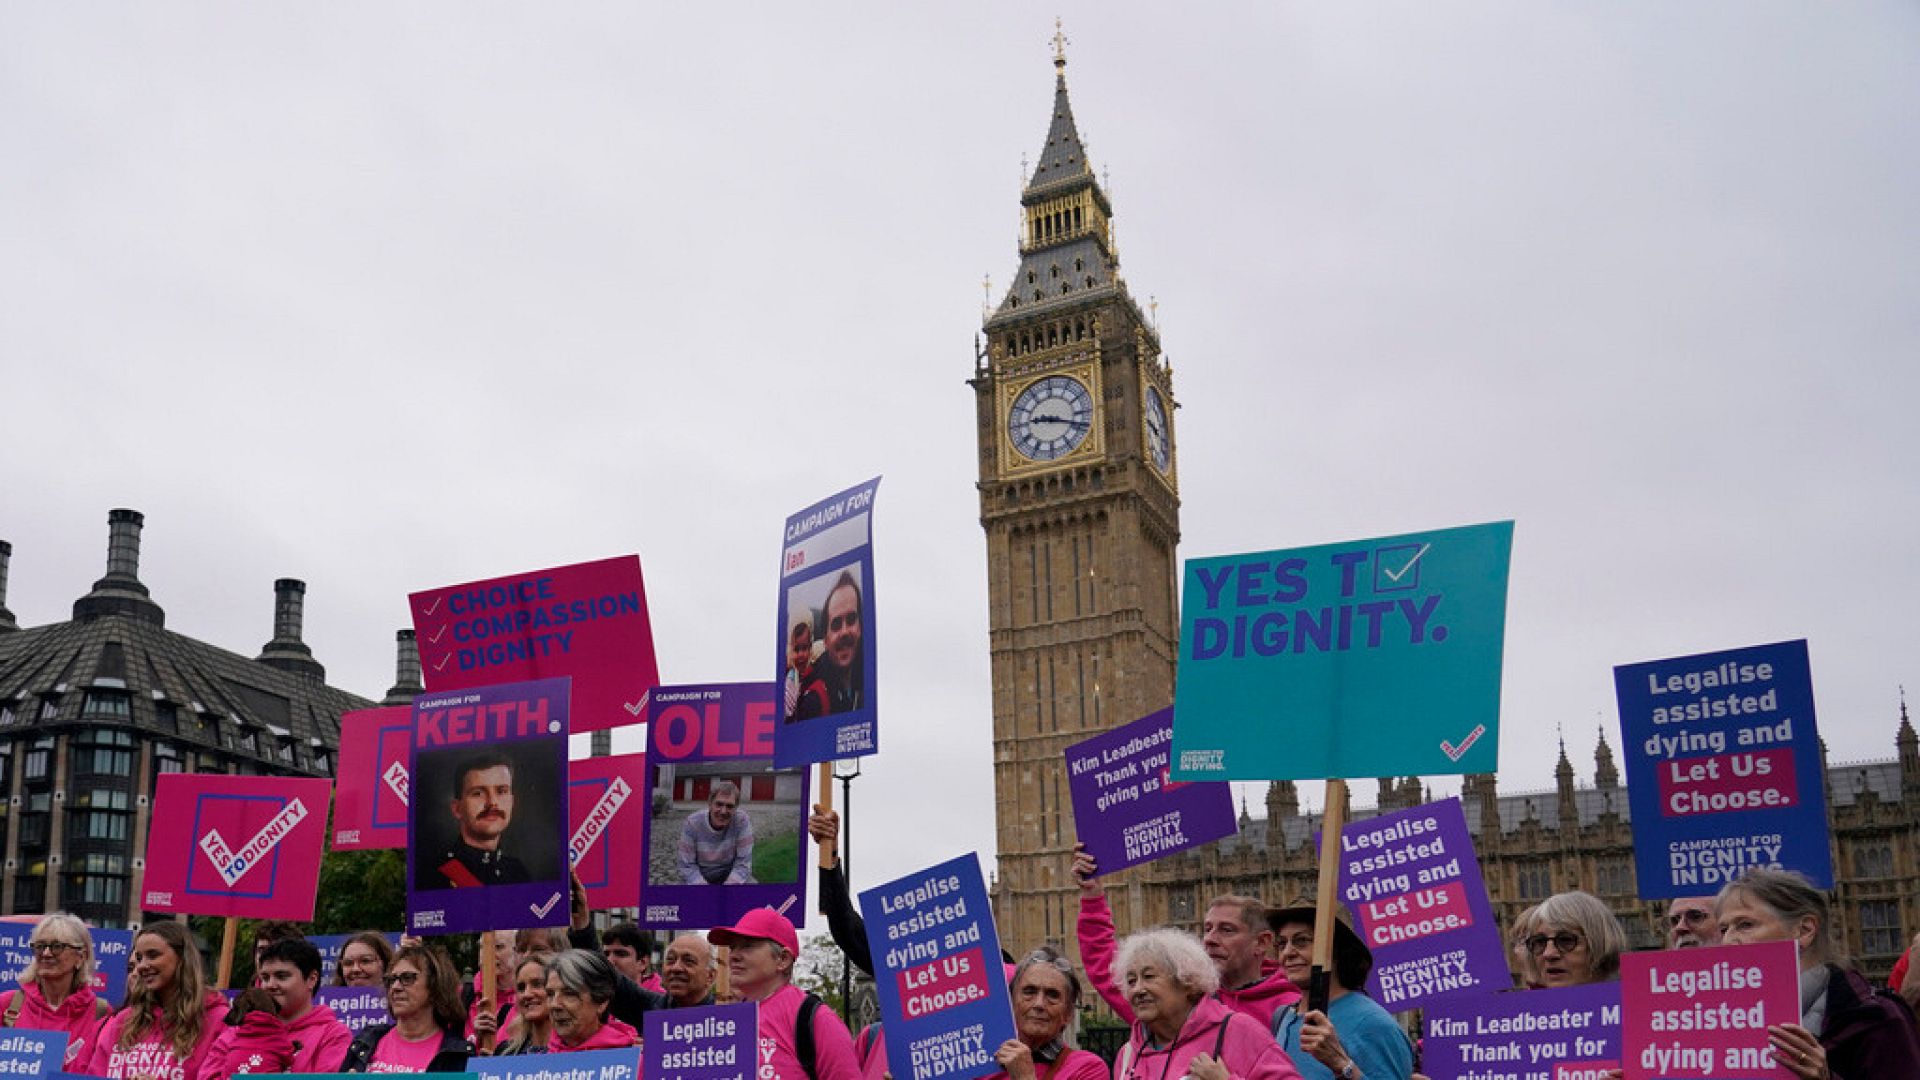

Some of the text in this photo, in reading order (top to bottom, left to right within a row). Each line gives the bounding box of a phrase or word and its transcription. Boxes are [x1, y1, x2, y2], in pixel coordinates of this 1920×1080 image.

[787, 488, 872, 540] CAMPAIGN FOR
[450, 578, 556, 615] CHOICE
[1195, 557, 1308, 610] YES
[453, 591, 640, 643] COMPASSION
[1191, 593, 1449, 661] DIGNITY.
[458, 629, 575, 672] DIGNITY
[1648, 662, 1774, 694] Legalise
[420, 695, 481, 709] CAMPAIGN FOR
[656, 691, 721, 702] CAMPAIGN FOR
[1653, 688, 1777, 725] assisted
[416, 698, 562, 748] KEITH.
[1644, 718, 1793, 758] dying and
[1072, 727, 1173, 776] Kim Leadbeate
[391, 766, 409, 797] YE
[1095, 762, 1138, 788] Thank
[1141, 752, 1167, 775] you
[1671, 755, 1772, 783] Let Us
[1096, 784, 1139, 812] giving
[1143, 777, 1160, 793] us
[1670, 788, 1790, 813] Choose.
[243, 803, 300, 862] DIGNITY
[573, 783, 626, 852] DIGNITY
[1123, 810, 1181, 835] CAMPAIGN FOR
[1124, 818, 1181, 848] DIGNITY
[1127, 832, 1189, 861] IN DYING.
[1342, 817, 1438, 852] Legalise
[1669, 834, 1782, 852] CAMPAIGN FOR
[206, 835, 231, 868] YES
[1349, 836, 1445, 876] assisted
[1670, 845, 1782, 869] DIGNITY
[225, 858, 245, 879] TO
[1346, 858, 1461, 901] dying and
[1671, 862, 1783, 886] IN DYI
[881, 875, 961, 915] Legalise
[1370, 890, 1449, 920] Let Us
[888, 897, 967, 940] assisted
[1373, 914, 1467, 944] Choose.
[5, 951, 36, 965] Tha
[100, 941, 127, 955] MP:
[886, 921, 980, 969] dying and
[905, 956, 970, 990] Let Us
[1377, 950, 1467, 976] CAMPAIGN FOR
[1380, 959, 1467, 990] DIGNITY
[1383, 972, 1480, 1003] IN DYING.
[1650, 962, 1763, 998] Legalise
[907, 983, 985, 1017] Choose.
[1652, 1001, 1765, 1031] assisted
[663, 1017, 736, 1043] Legalise
[910, 1023, 984, 1050] CAMPAIGN FOR
[1430, 1004, 1620, 1038] Kim Leadbeater M
[0, 1037, 46, 1054] alise
[661, 1044, 736, 1070] assisted
[912, 1032, 984, 1066] DIGNITY
[1459, 1036, 1607, 1063] Thank you for
[1641, 1041, 1777, 1075] dying and
[600, 1064, 632, 1080] MP:
[913, 1049, 994, 1080] IN DYING.
